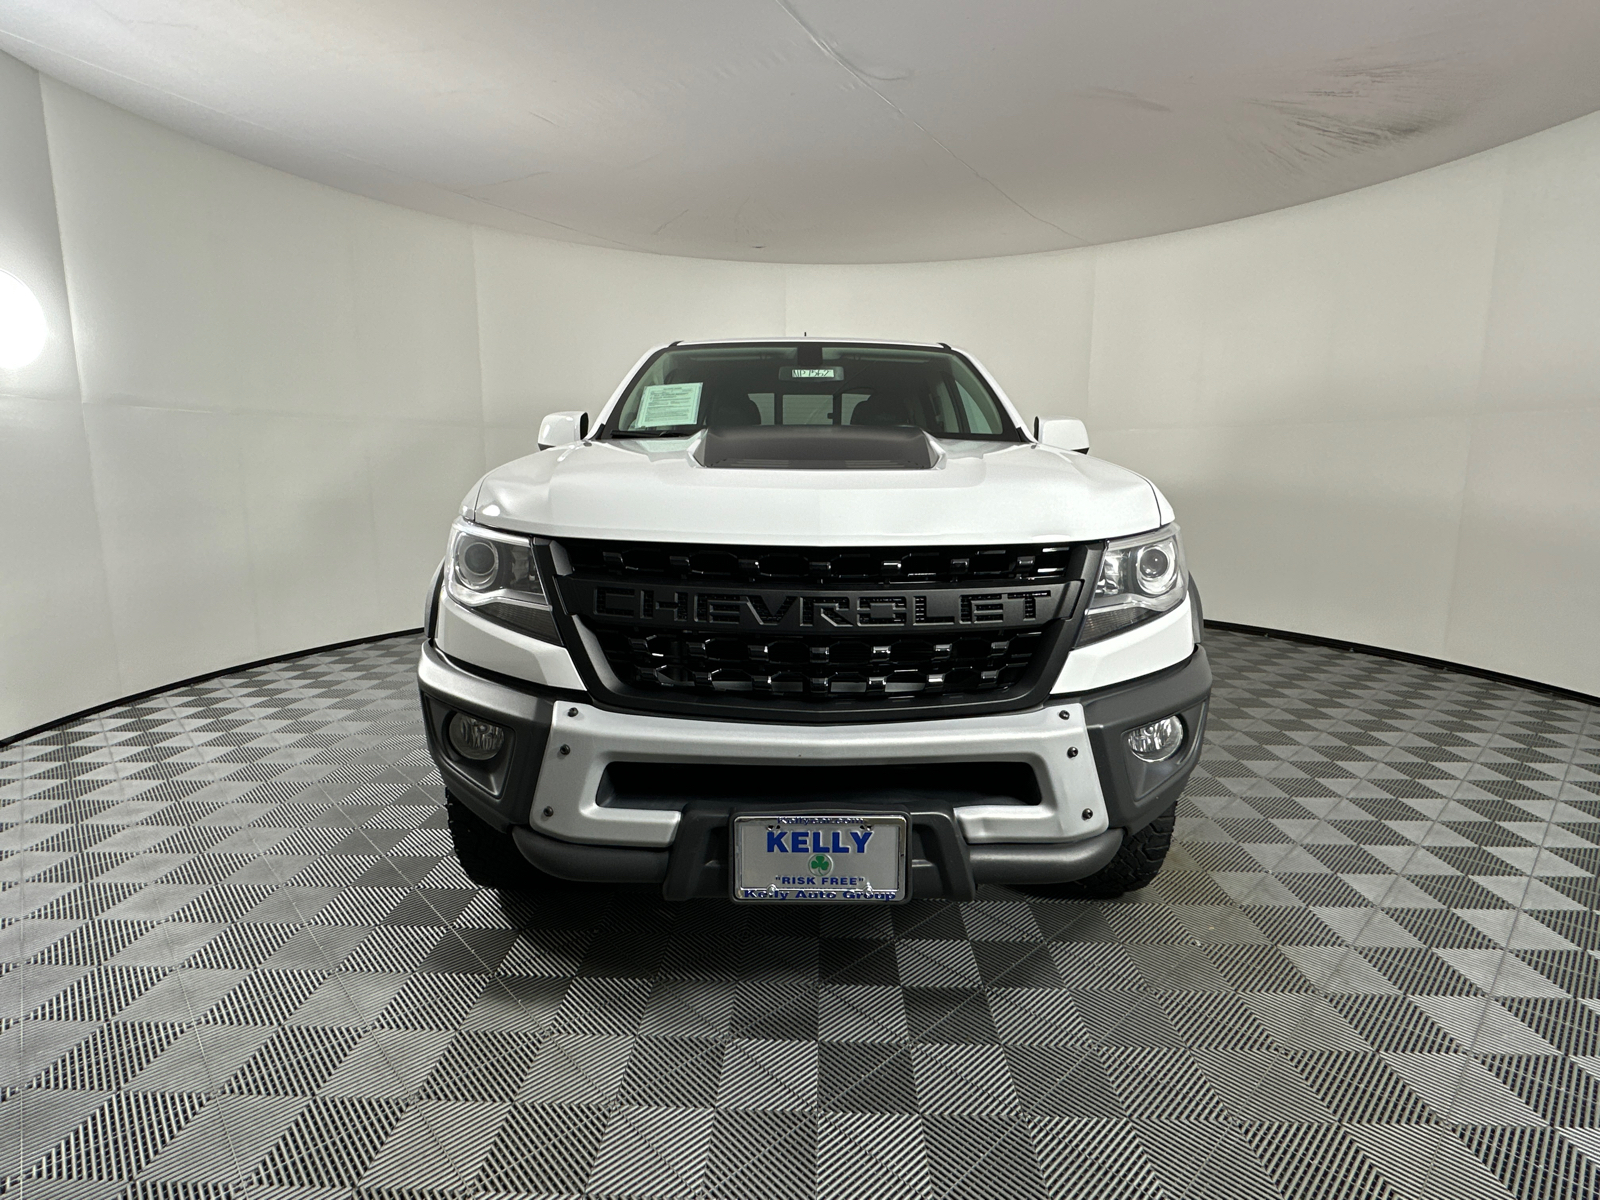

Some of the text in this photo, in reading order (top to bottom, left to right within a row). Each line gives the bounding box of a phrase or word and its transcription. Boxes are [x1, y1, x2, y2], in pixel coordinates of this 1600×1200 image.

[593, 586, 1053, 628] CHEVROLET
[766, 831, 874, 854] KELLY
[775, 876, 864, 886] "RISK FREE"
[744, 889, 897, 901] Kelly Auto Group
